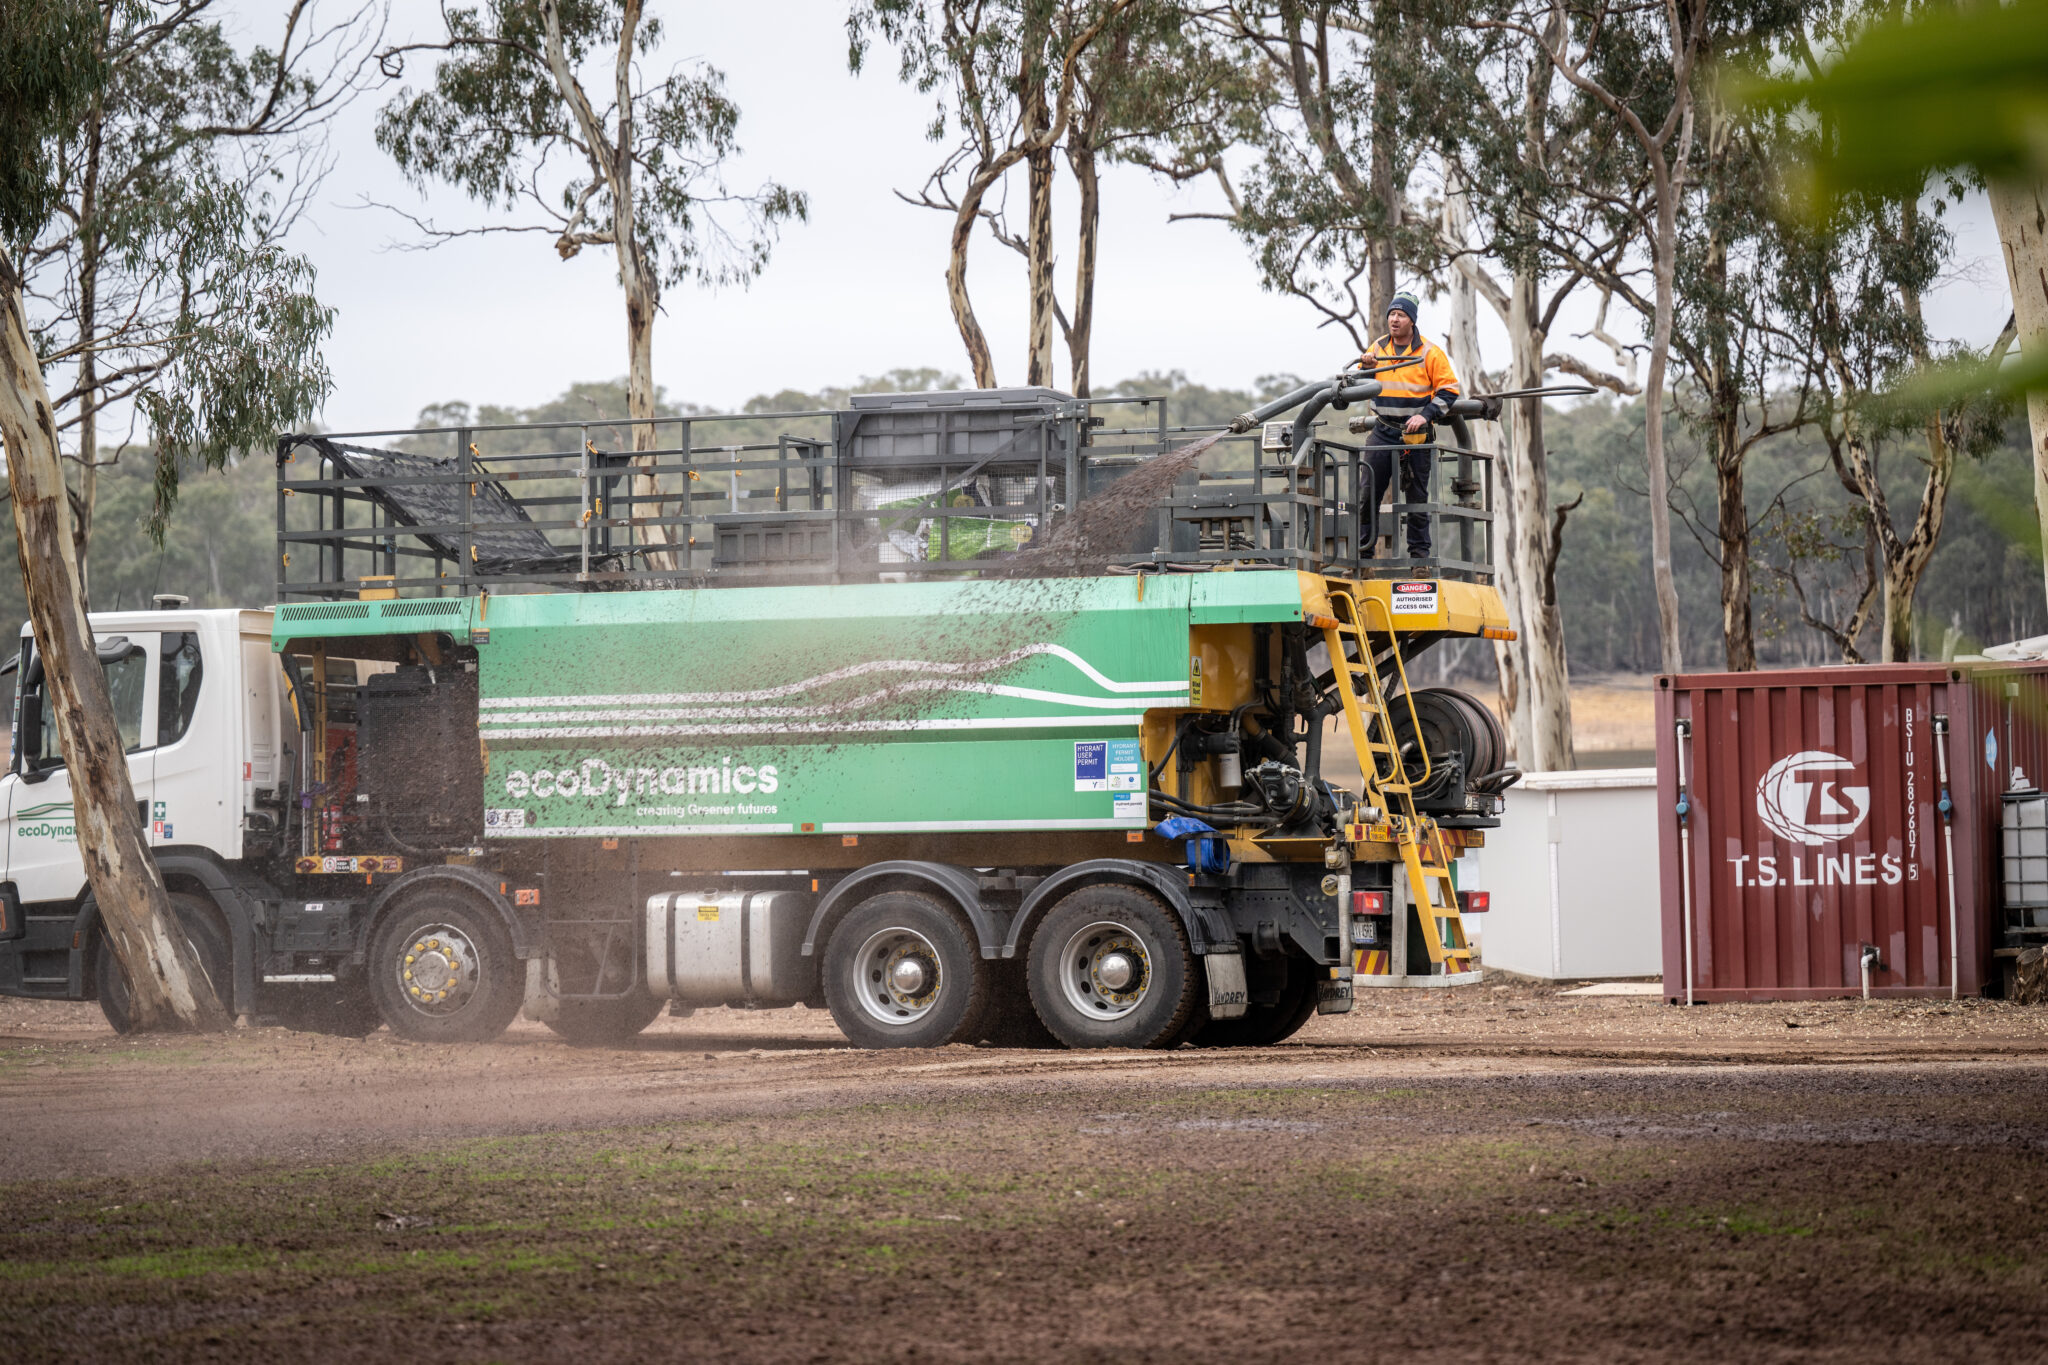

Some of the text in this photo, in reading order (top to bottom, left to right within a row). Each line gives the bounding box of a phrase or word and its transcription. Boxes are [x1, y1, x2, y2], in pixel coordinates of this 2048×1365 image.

[1077, 744, 1104, 752] HYDRANT
[1905, 708, 1914, 766] BSIU
[1077, 758, 1098, 766] PERMIT
[505, 756, 778, 806] ecoDynamics
[636, 803, 778, 818] creating Greener futures
[1907, 771, 1916, 859] 286607
